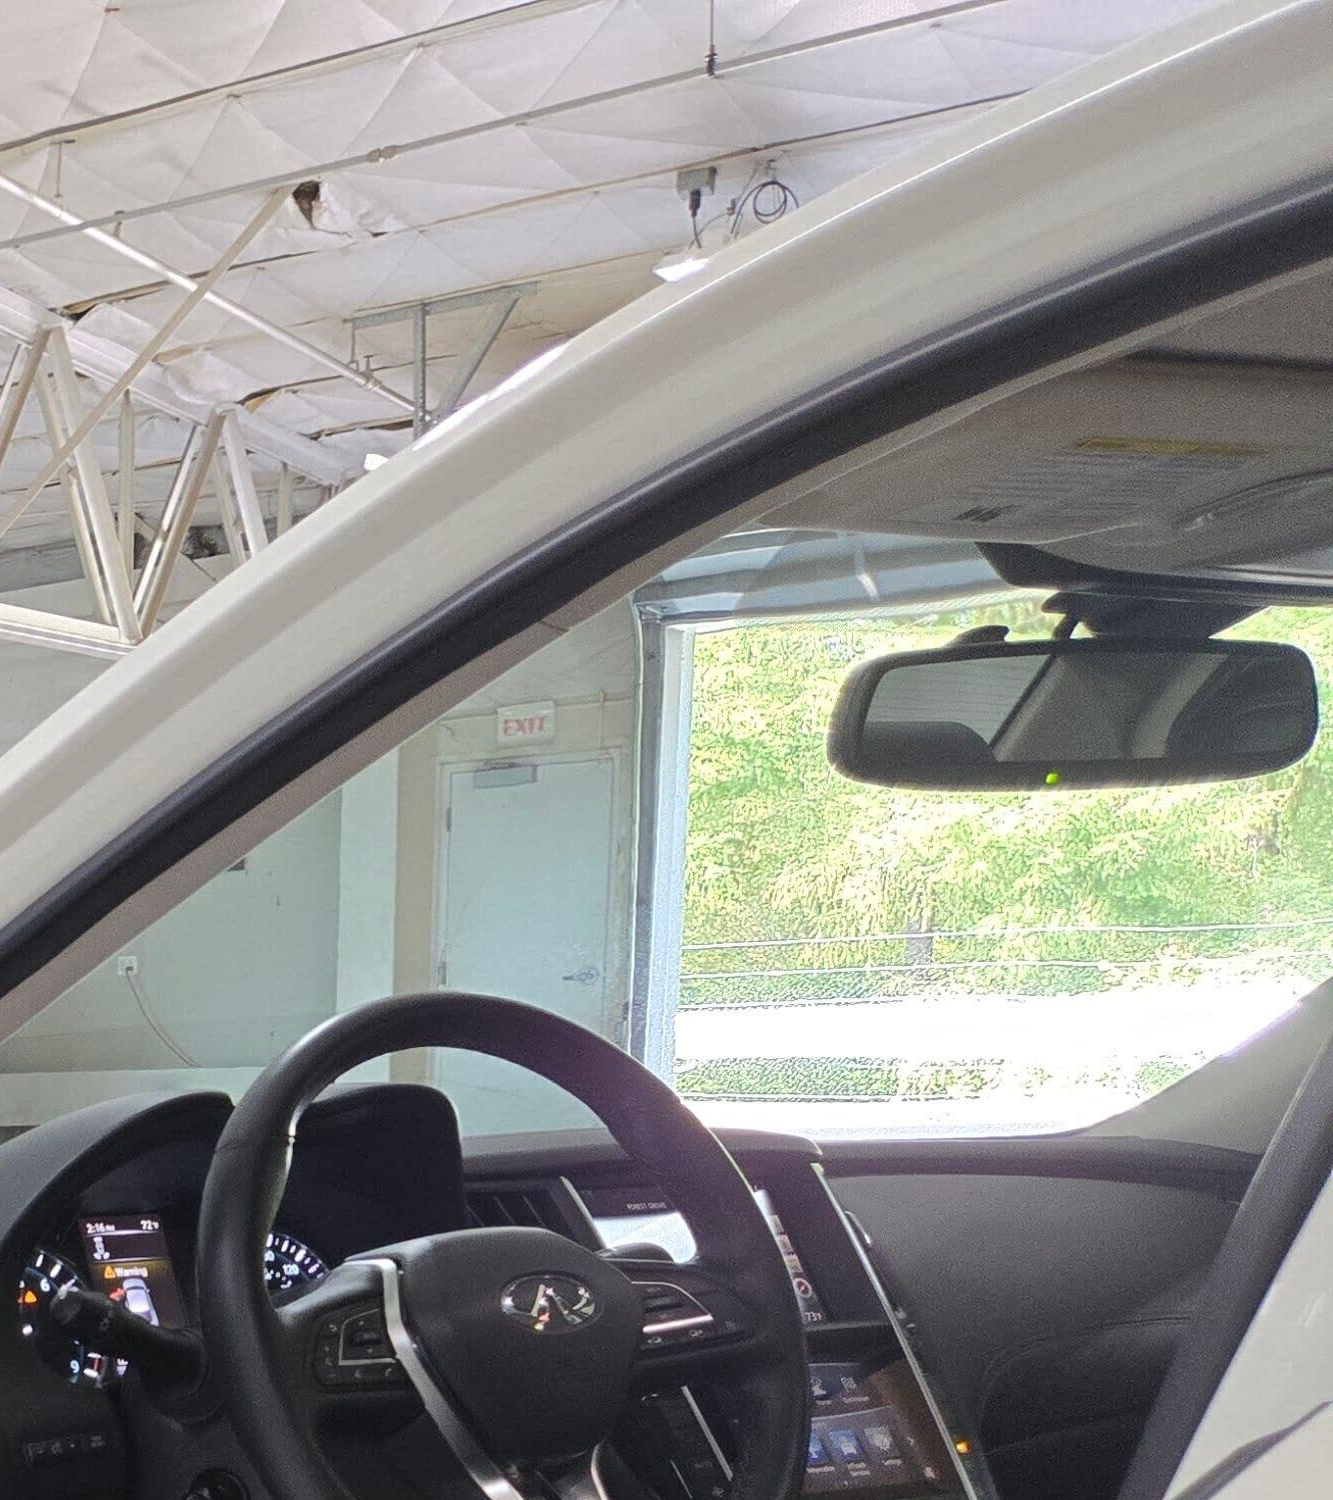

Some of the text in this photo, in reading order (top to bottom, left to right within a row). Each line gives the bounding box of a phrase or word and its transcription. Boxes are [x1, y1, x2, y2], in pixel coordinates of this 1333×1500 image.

[503, 716, 546, 736] EXIT
[114, 1266, 149, 1278] Warning
[39, 1277, 51, 1292] 6
[69, 1359, 80, 1373] 9
